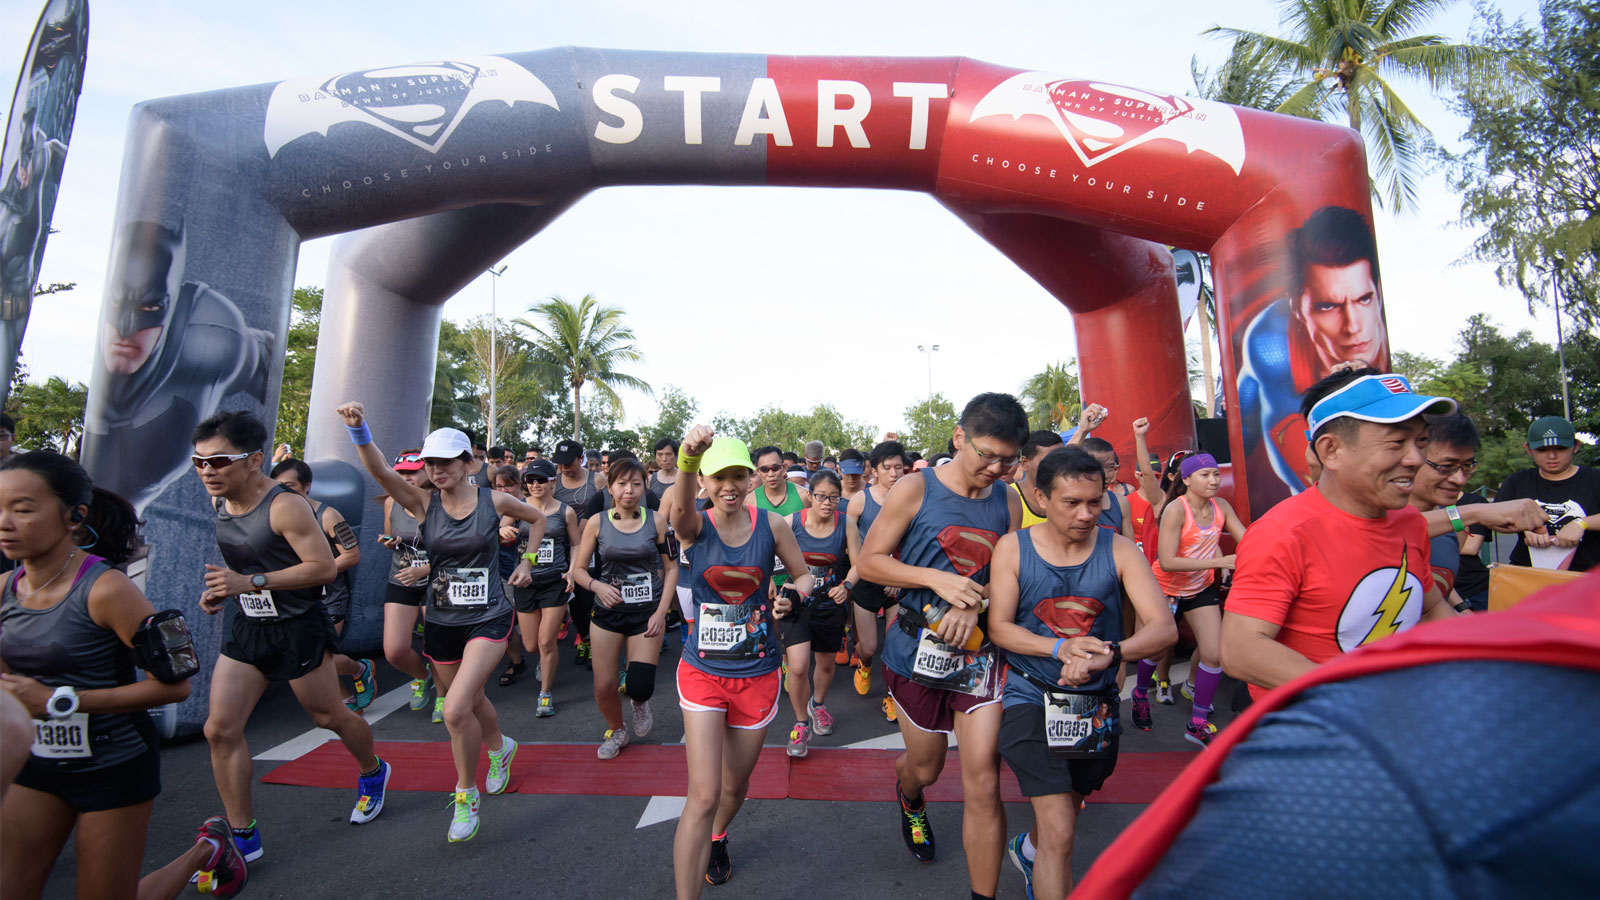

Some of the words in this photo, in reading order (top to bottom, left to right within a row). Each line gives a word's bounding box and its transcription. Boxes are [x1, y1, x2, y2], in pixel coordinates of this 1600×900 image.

[298, 83, 380, 102] BATMAN
[407, 68, 498, 86] SUPERMAN
[341, 95, 382, 108] DAWN
[392, 92, 409, 100] OF
[418, 82, 475, 96] JUSTICE
[592, 73, 948, 150] START
[1022, 83, 1090, 101] BATMAN
[1114, 97, 1207, 121] SUPERMAN
[1046, 98, 1081, 109] DAWN
[1090, 105, 1105, 113] OF
[1113, 110, 1169, 126] JUSTICE
[302, 169, 409, 198] CHOOSE
[425, 154, 486, 173] YOUR
[502, 143, 553, 160] SIDE
[972, 153, 1057, 178] CHOOSE
[1072, 173, 1131, 194] YOUR
[1147, 190, 1205, 211] SIDE
[241, 596, 271, 610] 11384
[452, 584, 485, 597] 11381
[624, 586, 650, 598] 10153
[36, 724, 82, 746] 1380
